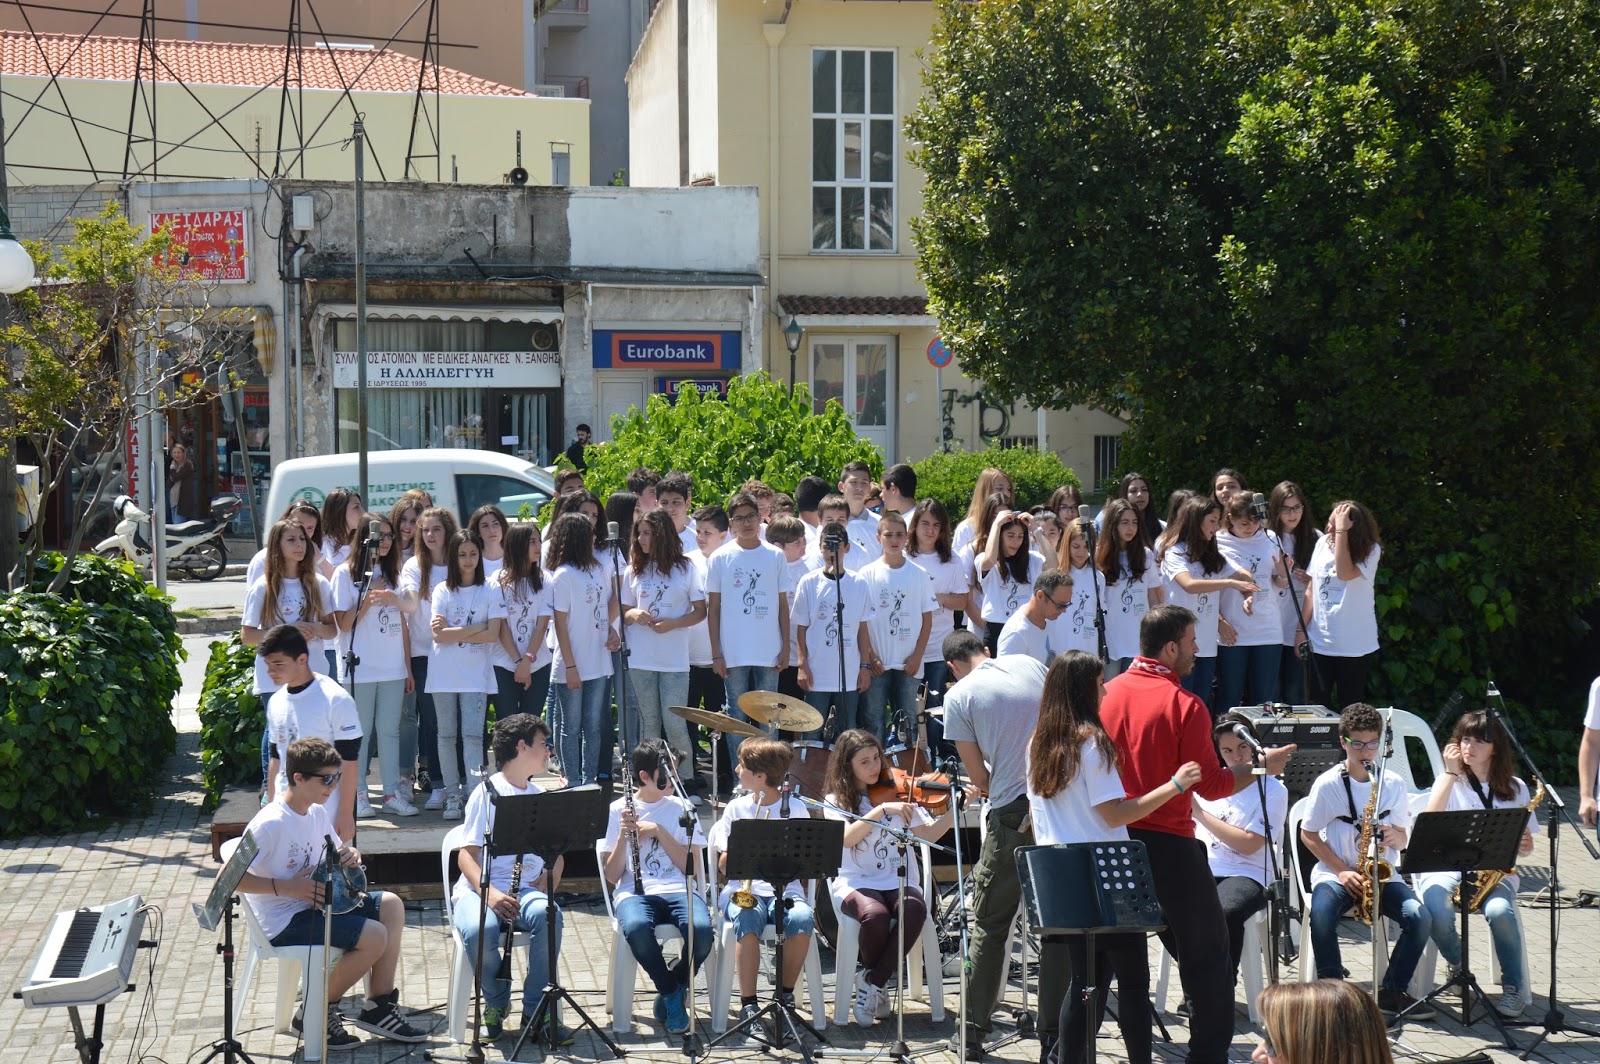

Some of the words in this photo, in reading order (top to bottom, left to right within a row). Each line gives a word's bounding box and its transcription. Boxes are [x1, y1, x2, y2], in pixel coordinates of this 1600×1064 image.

[627, 344, 706, 359] Eurobank
[335, 352, 380, 364] ΣΥΛΛΟΣ
[381, 352, 417, 364] ΑΤΟΜΩΝ
[423, 352, 435, 364] ΜΕ
[437, 352, 470, 364] ΕΙΔΙΚΕΣ
[471, 352, 510, 364] ΑΝΑΓΚΕΣ
[525, 352, 560, 364] ΞΑΝΘΗΣ
[380, 367, 391, 378] Η
[395, 367, 494, 378] ΑΛΛΗΛΕΓΓΥΗ
[673, 382, 719, 392] Ebank
[335, 482, 436, 493] ΝΤΑΙΡΙΣΜΟΣ
